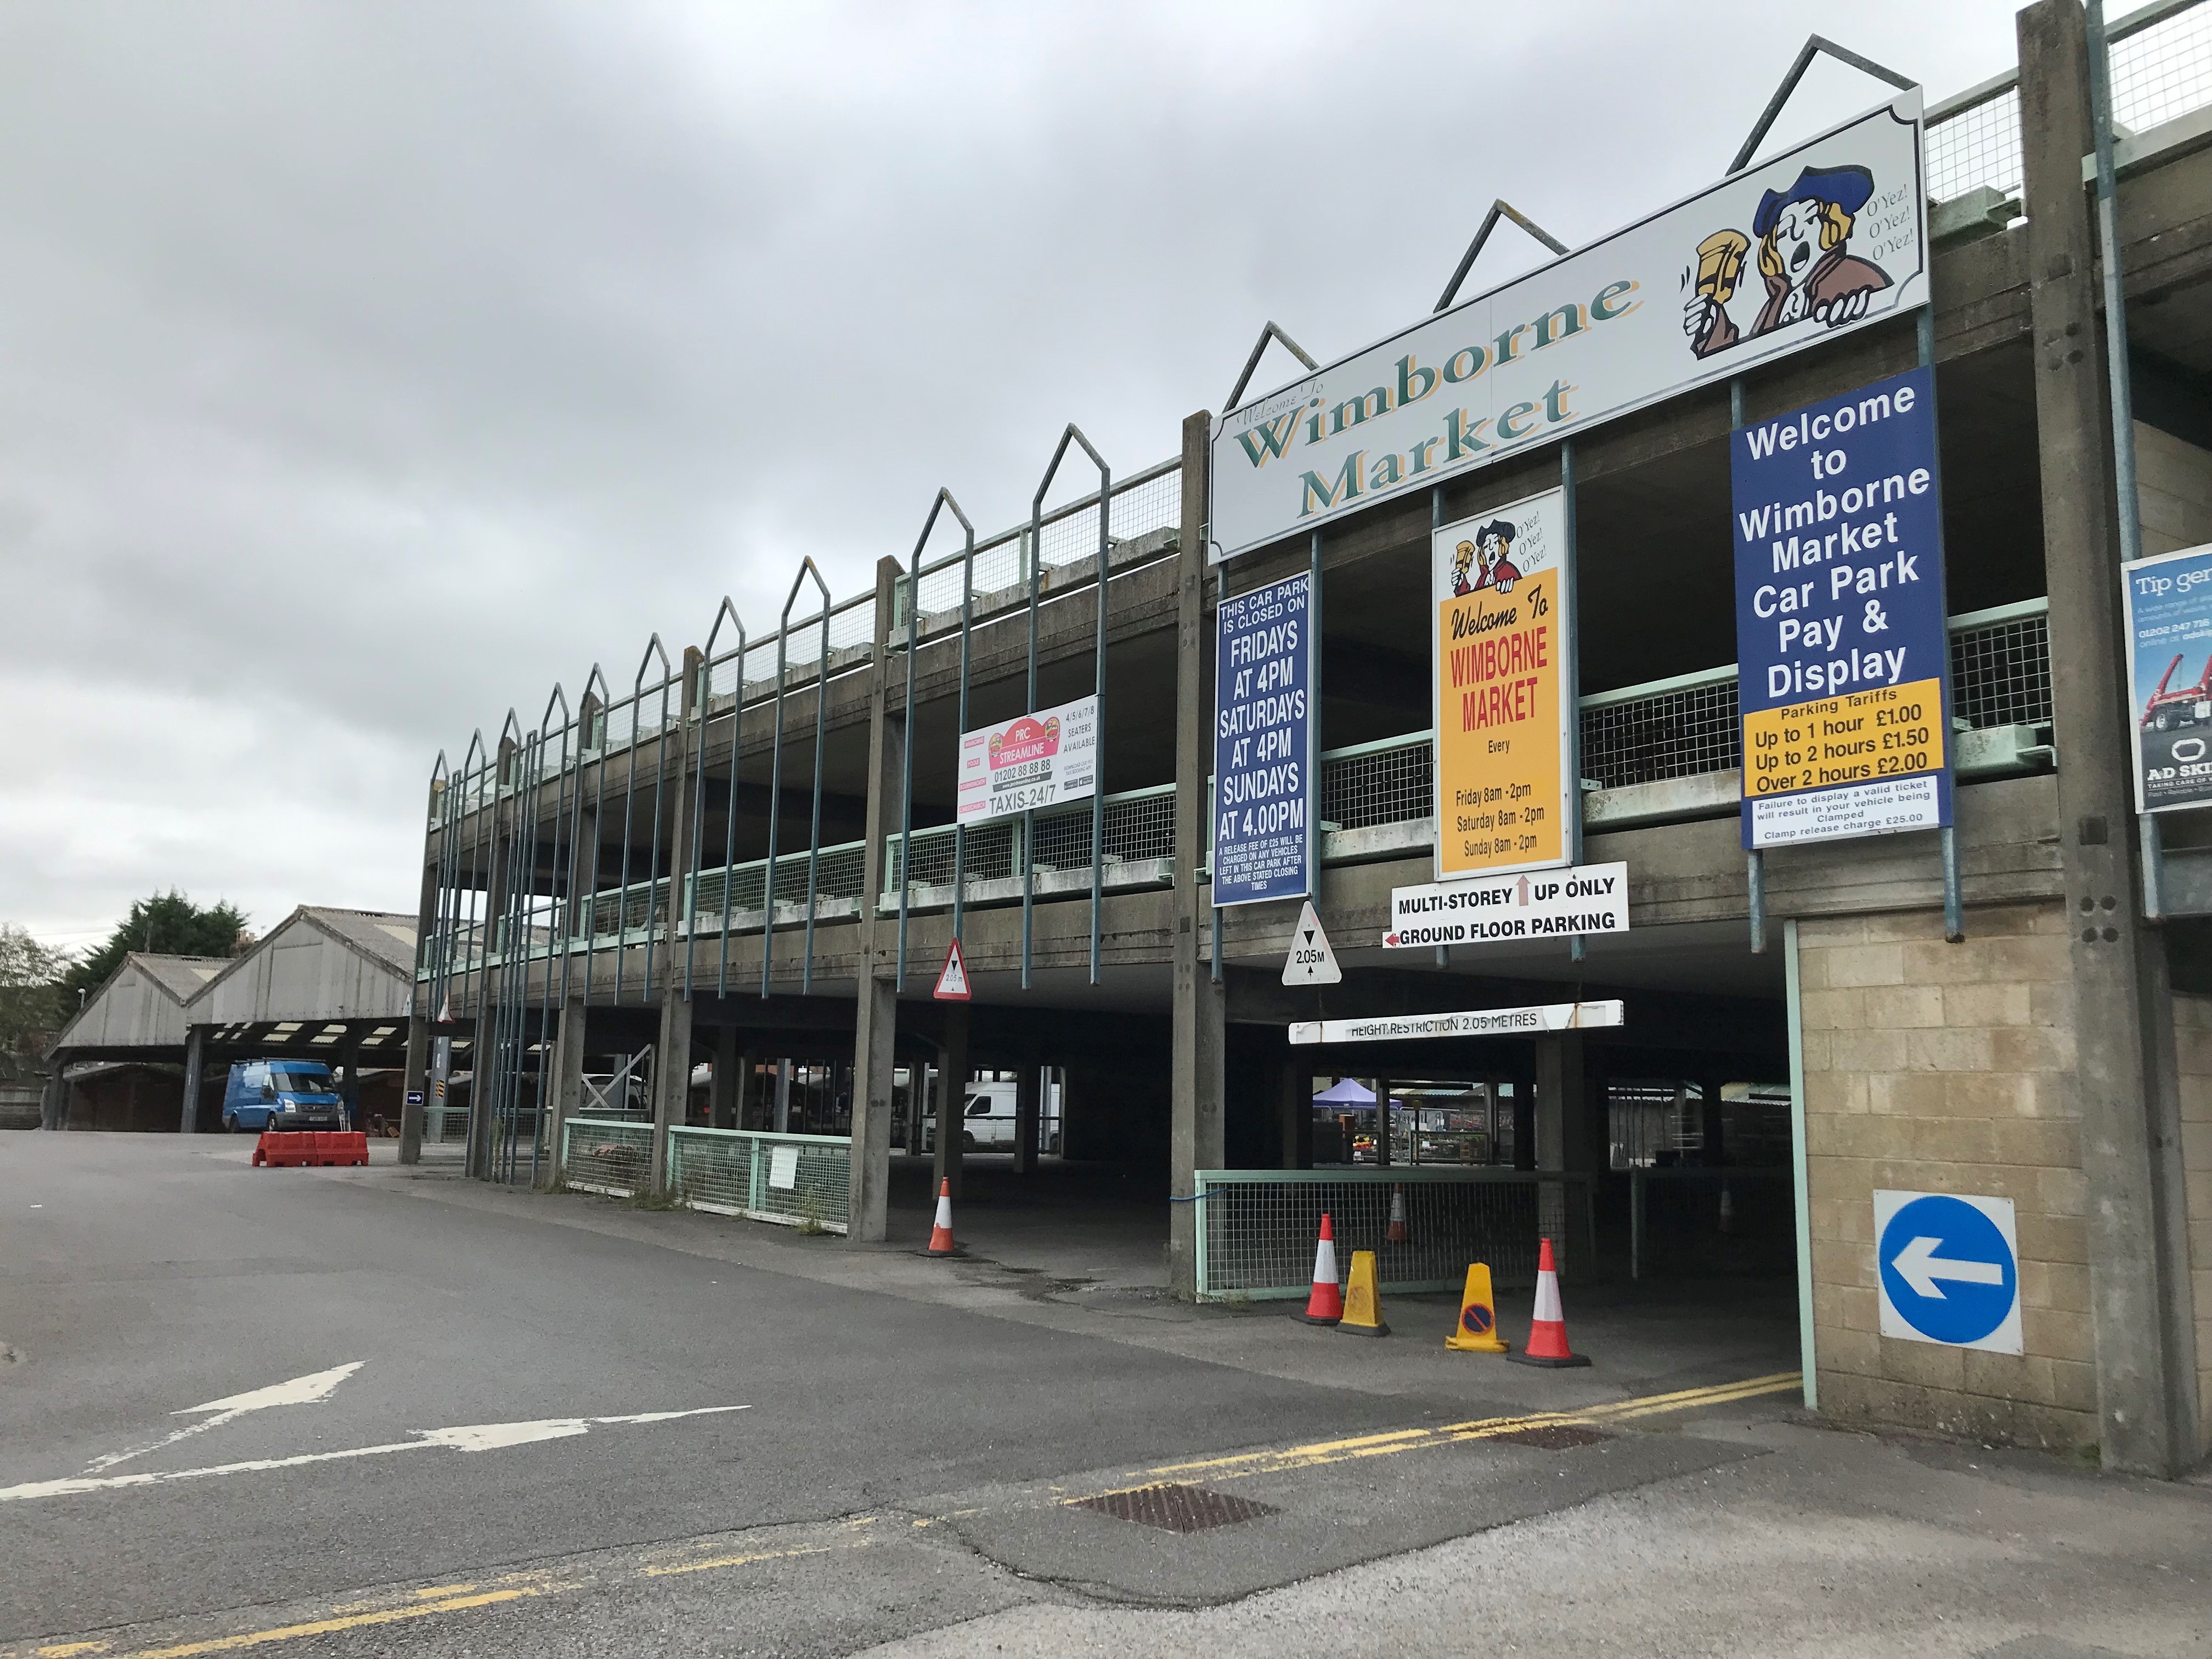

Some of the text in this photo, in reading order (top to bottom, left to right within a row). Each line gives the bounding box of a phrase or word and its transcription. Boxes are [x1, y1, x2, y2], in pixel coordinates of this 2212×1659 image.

[1867, 184, 1908, 216] O'Yez!
[1869, 206, 1911, 238] O'Yez!
[1873, 228, 1914, 260] O'Yez!
[1233, 280, 1644, 468] Wimborne
[1237, 378, 1323, 425] Welcome To
[1746, 386, 1915, 461] Welcome
[1297, 379, 1581, 519] Market
[1811, 449, 1847, 480] to
[1739, 467, 1930, 543] Wimborne
[1516, 511, 1540, 539] O'Yez!
[1519, 528, 1543, 555] O'Yez!
[1773, 512, 1898, 573] Market
[1523, 545, 1547, 572] O'Yez!
[1220, 577, 1309, 620] THIS CAR PARK
[1754, 550, 1919, 618] Car Park
[2136, 576, 2172, 596] Tip
[1223, 595, 1305, 634] IS CLOSED ON
[1451, 584, 1548, 640] Welcome To
[1779, 599, 1888, 653] Pay &
[1231, 620, 1298, 667] FRIDAYS
[1451, 626, 1547, 688] WIMBORNE
[1233, 656, 1293, 701] AT 4PM
[1768, 646, 1906, 699] Display
[1066, 706, 1094, 722] 4/5/6/7/8
[1220, 689, 1305, 738] SATURDAYS
[1463, 676, 1538, 732] MARKET
[1781, 689, 1897, 720] Parking Tariffs
[1015, 727, 1031, 742] PRC
[1068, 723, 1091, 738] SEATERS
[1756, 704, 1922, 749] Up to 1 hour £1.00
[999, 742, 1044, 764] STREAMLINE
[1063, 736, 1095, 753] AVAILABLE
[1232, 727, 1291, 769] AT 4PM
[1488, 740, 1510, 754] Every
[1756, 727, 1929, 772] Up to 2 hours £1.50
[995, 759, 1050, 782] 01202 88 88 88
[1224, 762, 1299, 805] SUNDAYS
[1757, 752, 1927, 792] Over 2 hours £2.00
[2179, 762, 2212, 777] SKI
[1456, 789, 1481, 808] Friday
[1484, 787, 1502, 803] 8am
[1759, 799, 1792, 810] Failure
[1812, 792, 1848, 803] display
[1864, 786, 1891, 795] valid
[1895, 781, 1927, 791] ticket
[1779, 808, 1808, 817] result
[1826, 803, 1850, 812] your
[1855, 796, 1893, 808] vehicle
[1898, 792, 1930, 802] being
[1219, 798, 1303, 842] AT 4.00PM
[1457, 812, 1494, 832] Saturday
[1498, 810, 1516, 826] 8am
[1764, 813, 1923, 839] Clamp release charge £25.00
[1817, 810, 1864, 822] Clamped
[1219, 834, 1303, 856] A RELEASE FEE OF £25 WILL BE
[1223, 845, 1298, 865] CHARGED ON ANY VEHICLES
[1465, 838, 1492, 858] Sunday
[1494, 838, 1511, 854] 8am
[1220, 855, 1301, 875] LEFT IN THIS CAR PARK AFTER
[1222, 866, 1298, 884] THE ABOVE STATED CLOSING
[1251, 881, 1267, 890] TIMES
[1398, 877, 1615, 914] MULTI-STOREY UP ONLY
[1400, 912, 1615, 945] GROUND FLOOR PARKING
[1352, 1013, 1536, 1036] HEIGHT RESTRICTION 2.05 METRES
